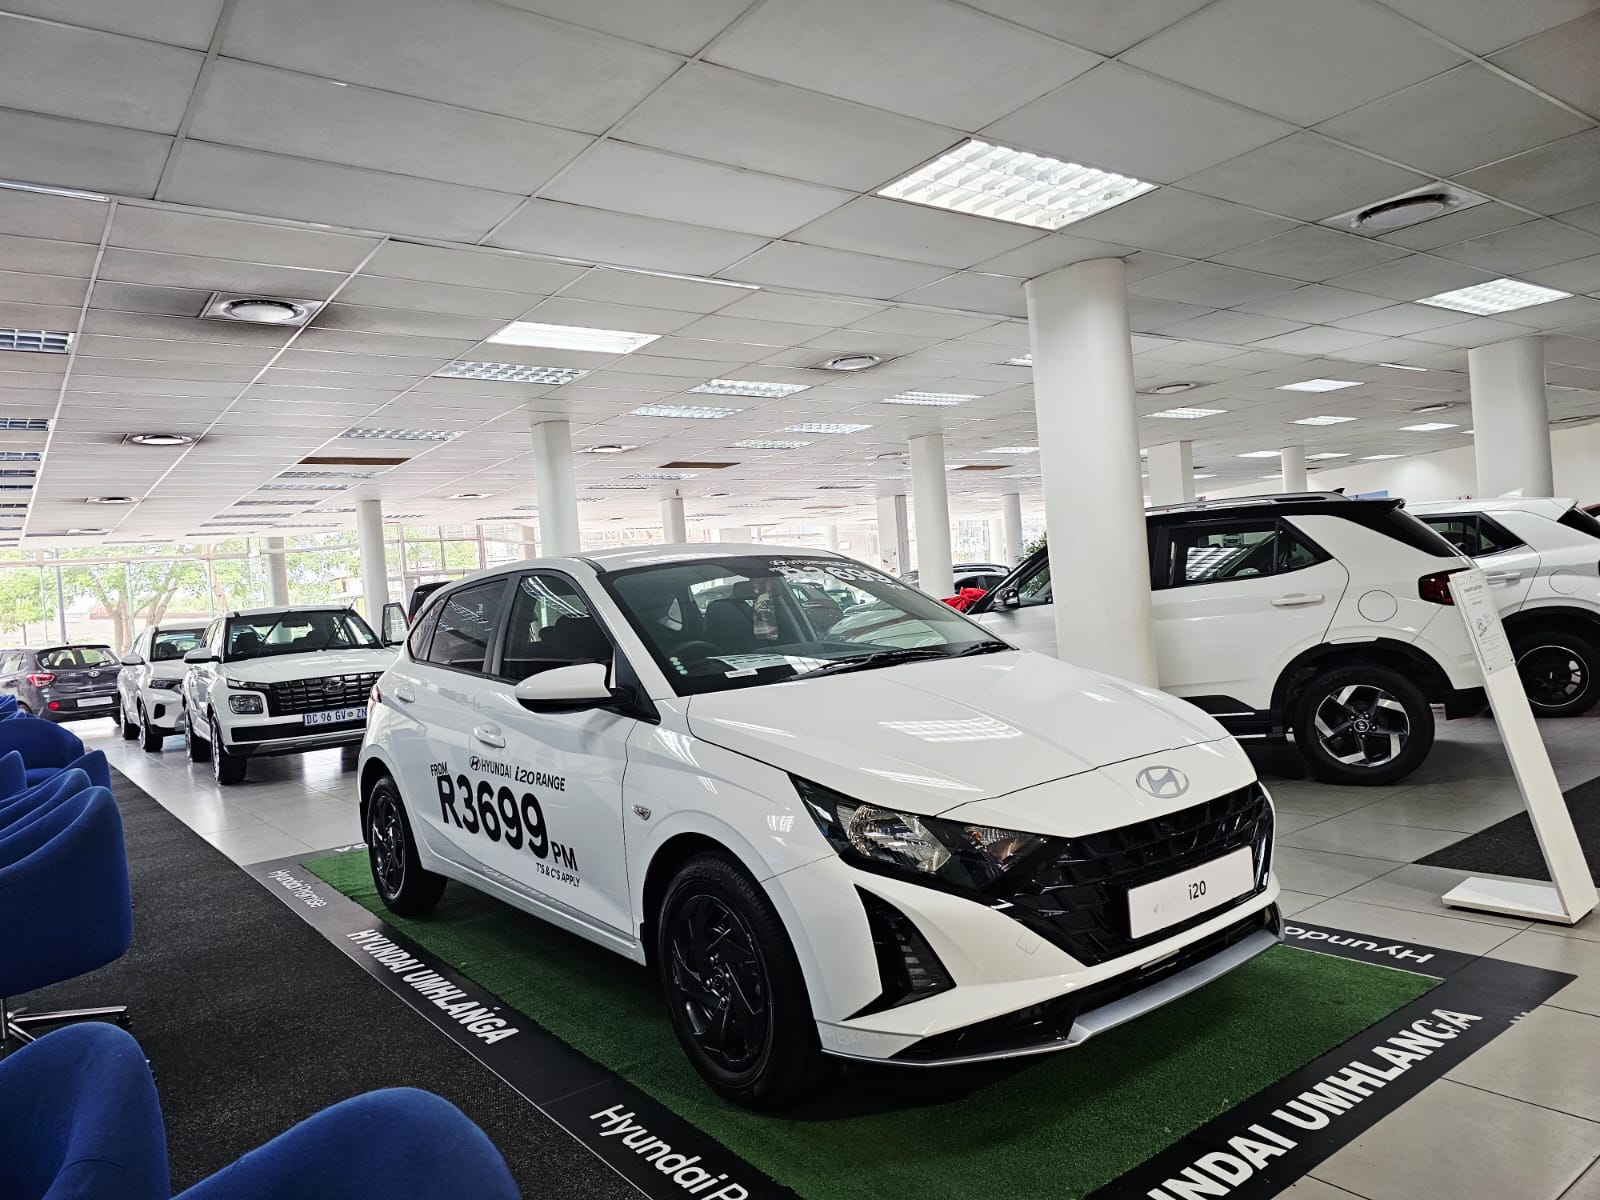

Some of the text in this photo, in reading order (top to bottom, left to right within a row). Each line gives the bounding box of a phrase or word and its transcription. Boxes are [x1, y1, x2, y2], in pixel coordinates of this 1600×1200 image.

[306, 714, 318, 725] DC
[320, 712, 332, 722] 96
[335, 710, 346, 721] GV
[430, 761, 448, 776] FROM
[480, 759, 566, 792] HYUNDAI i20 RANGE
[437, 774, 578, 871] R3699 PM
[561, 872, 581, 888] APPLY
[1187, 880, 1207, 901] i20
[1284, 926, 1435, 964] Hyunda
[346, 929, 519, 1045] HYUNDAI UMHLANGA
[1146, 1008, 1484, 1200] NDAI UMHLANGA
[589, 1103, 729, 1195] Hyundai
